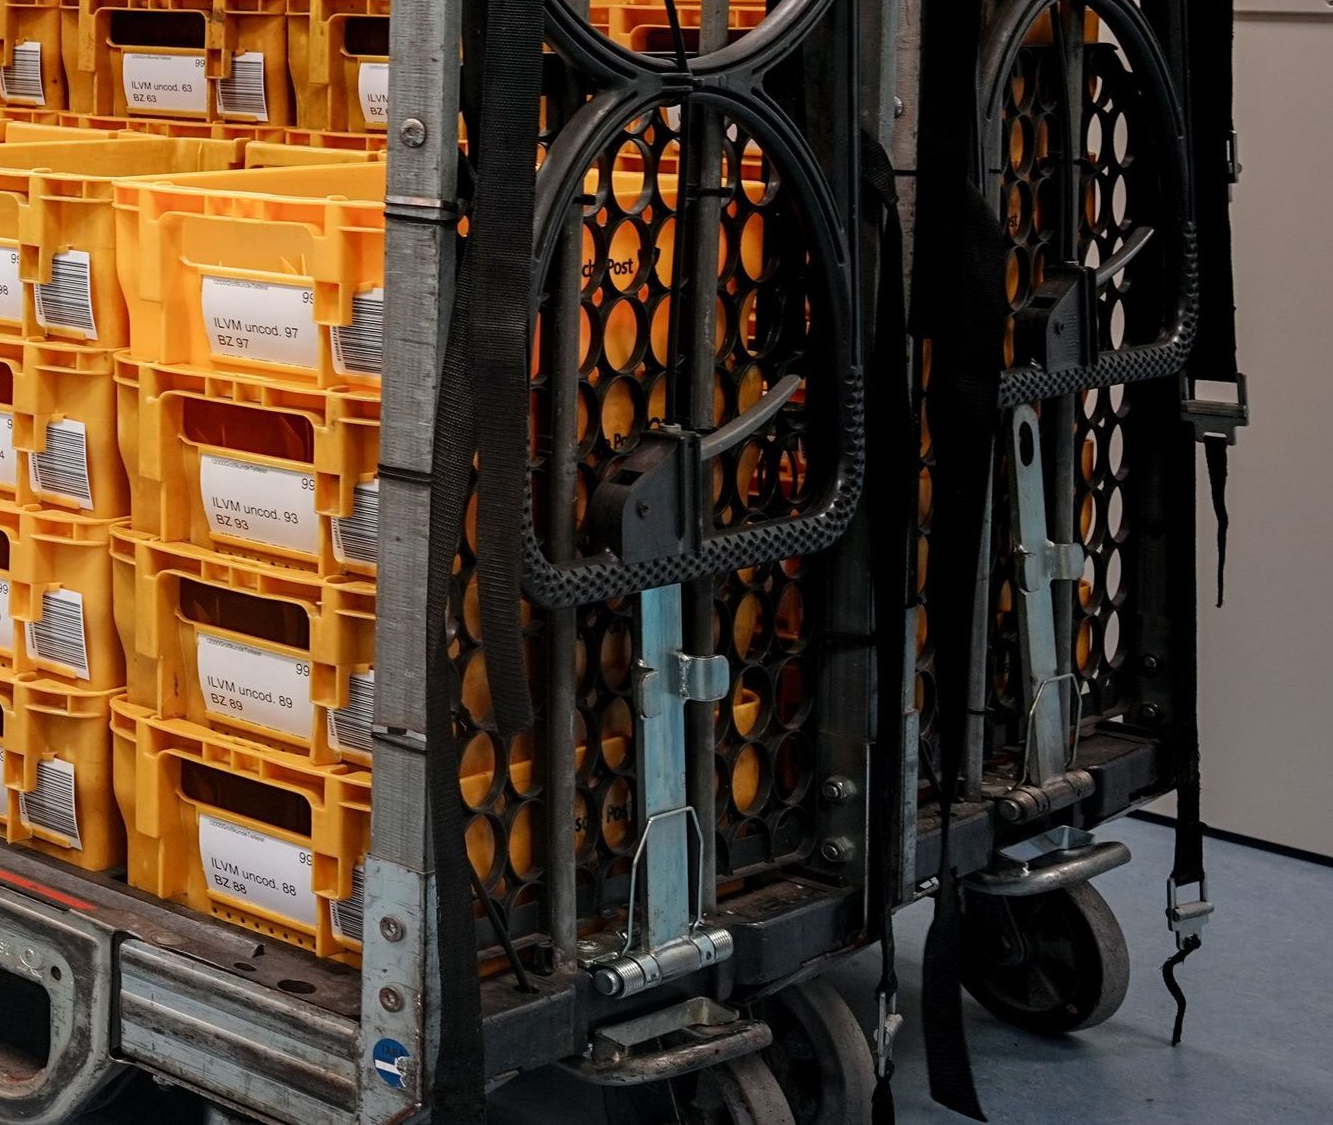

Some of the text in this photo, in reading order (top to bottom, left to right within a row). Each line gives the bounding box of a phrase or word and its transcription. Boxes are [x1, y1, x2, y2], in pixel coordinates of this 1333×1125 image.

[131, 81, 152, 90] ILVM
[181, 84, 193, 93] 63
[133, 93, 157, 103] BZ 63
[608, 259, 634, 275] Post
[214, 317, 298, 338] ILVM uncod. 97
[217, 334, 249, 349] BZ 97
[212, 497, 299, 524] ILVM uncod. 93
[216, 514, 249, 530] BZ 93
[207, 675, 293, 709] ILVM uncod. 89
[210, 693, 243, 711] BZ 89
[211, 857, 297, 897] ILVM uncod. 88
[214, 874, 247, 894] BZ 88
